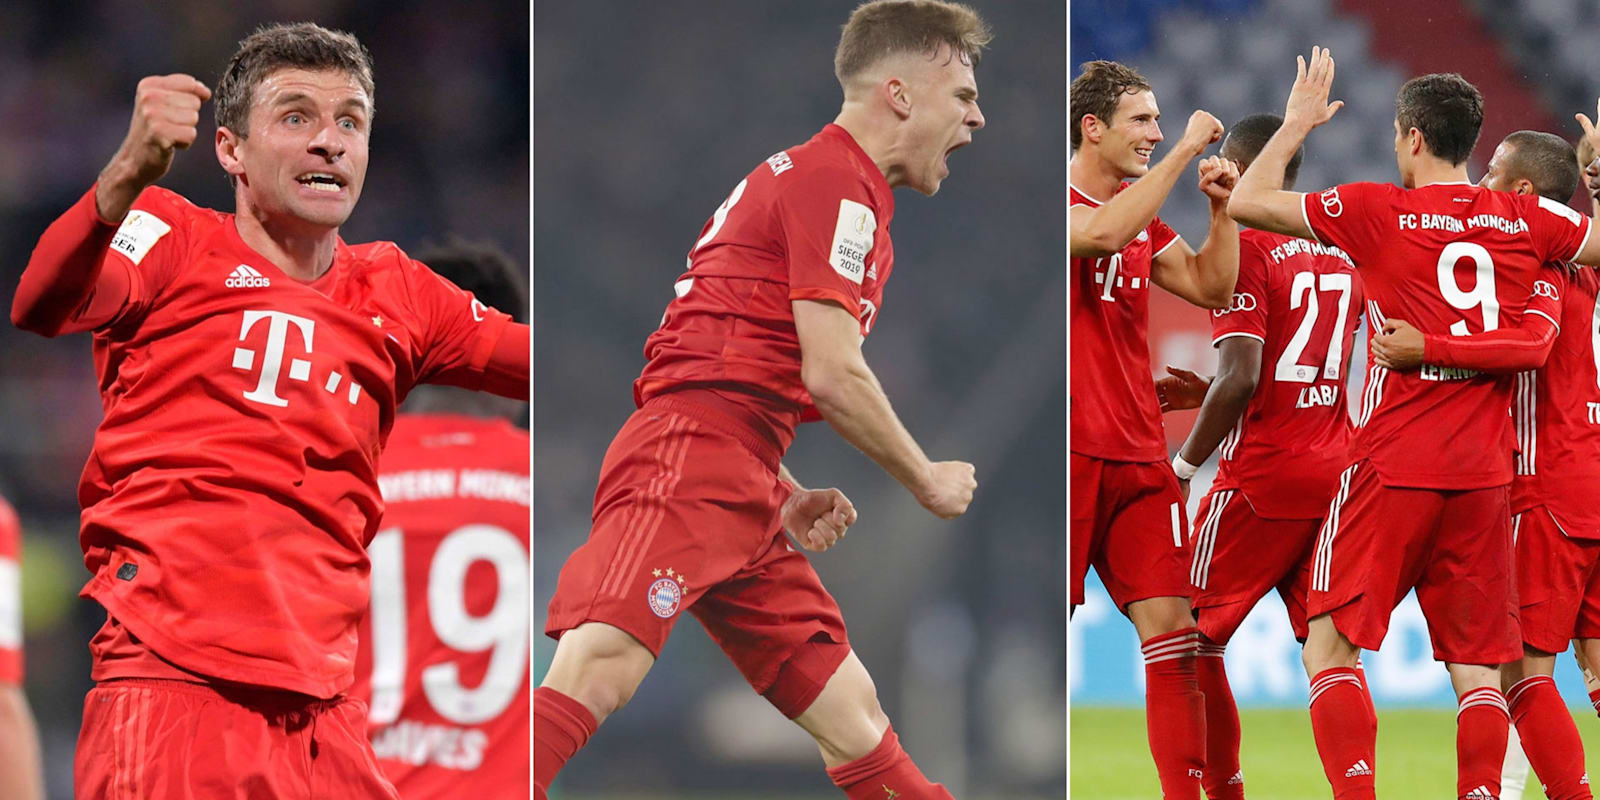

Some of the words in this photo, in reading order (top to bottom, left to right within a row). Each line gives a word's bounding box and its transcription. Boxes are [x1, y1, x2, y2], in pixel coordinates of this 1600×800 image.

[1398, 214, 1418, 231] FC
[1420, 213, 1466, 233] BAYERN
[837, 244, 865, 264] SIEGE
[1270, 245, 1287, 265] FC
[839, 257, 862, 275] 2019
[225, 276, 271, 288] adidas
[1436, 241, 1500, 337] 9
[1274, 271, 1352, 384] 27
[368, 524, 530, 726] 19
